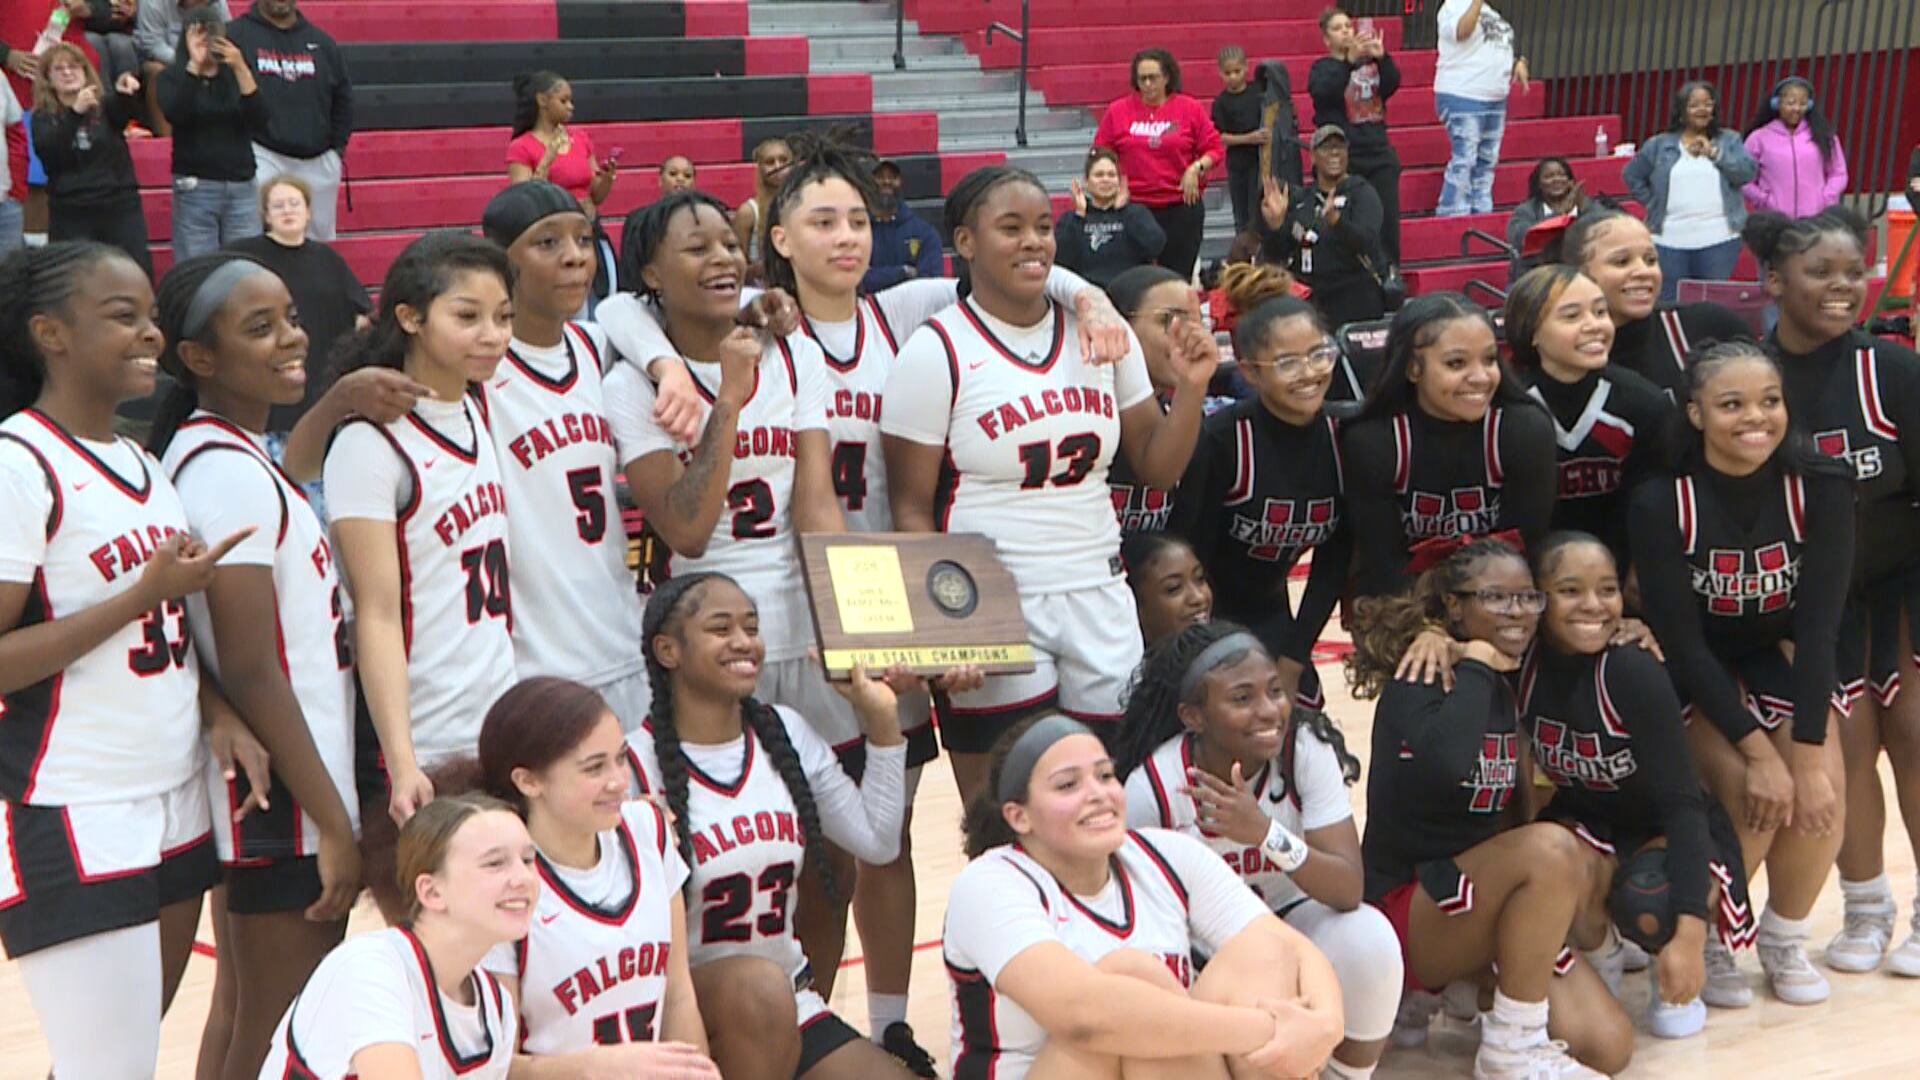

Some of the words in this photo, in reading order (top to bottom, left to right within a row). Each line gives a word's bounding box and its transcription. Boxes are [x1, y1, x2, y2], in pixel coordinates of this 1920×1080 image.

[976, 386, 1113, 441] FALCONS
[1018, 431, 1101, 491] 13
[566, 466, 607, 546] 5
[727, 477, 778, 541] 2
[931, 647, 1009, 664] CHAMPIONS
[701, 860, 796, 945] 23
